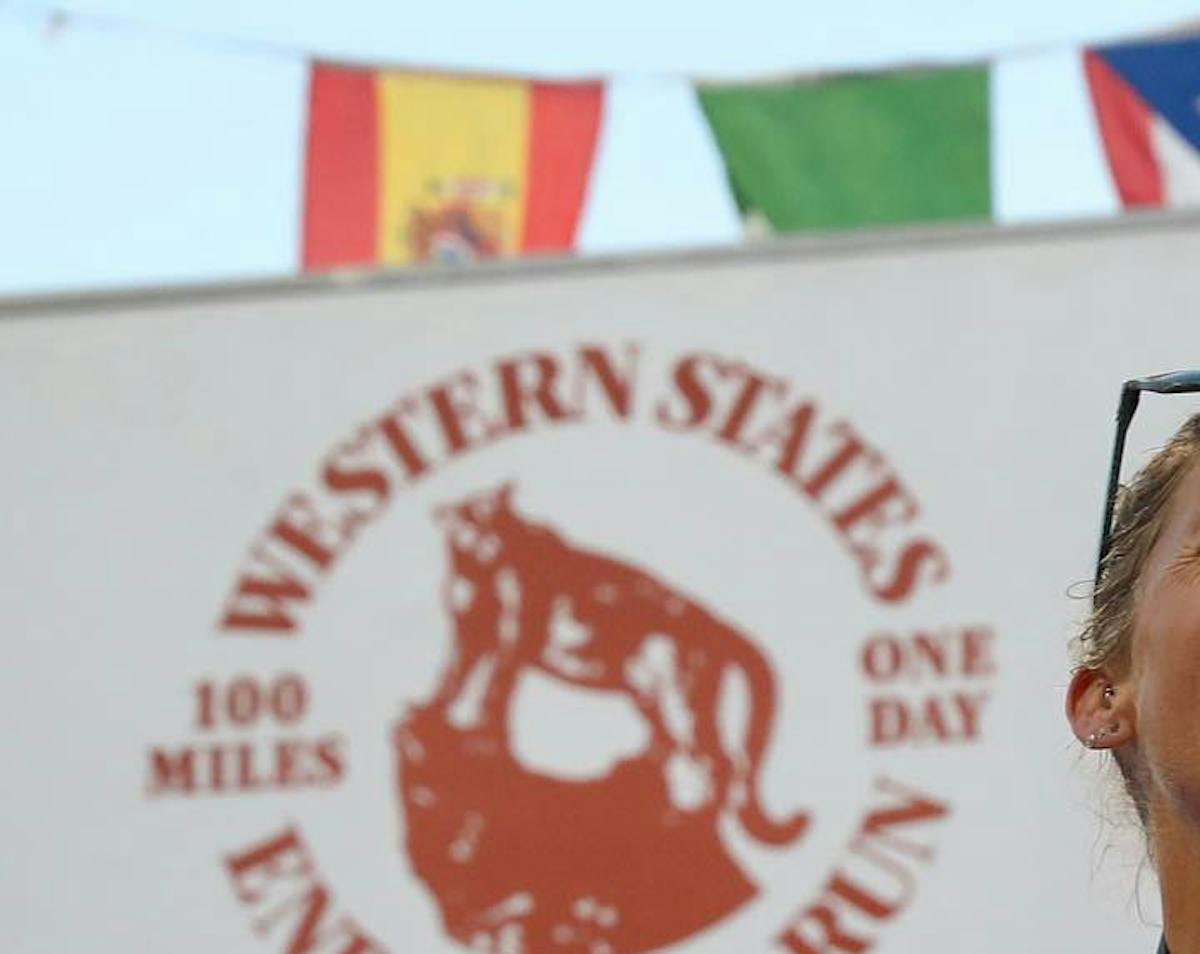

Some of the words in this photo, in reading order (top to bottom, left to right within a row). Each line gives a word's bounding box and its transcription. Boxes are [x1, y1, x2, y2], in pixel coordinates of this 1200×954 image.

[217, 343, 640, 640] WESTERN
[655, 351, 952, 606] STATES
[860, 628, 997, 682] ONE
[194, 675, 307, 731] 100
[868, 690, 987, 748] DAY
[145, 735, 346, 799] MILES
